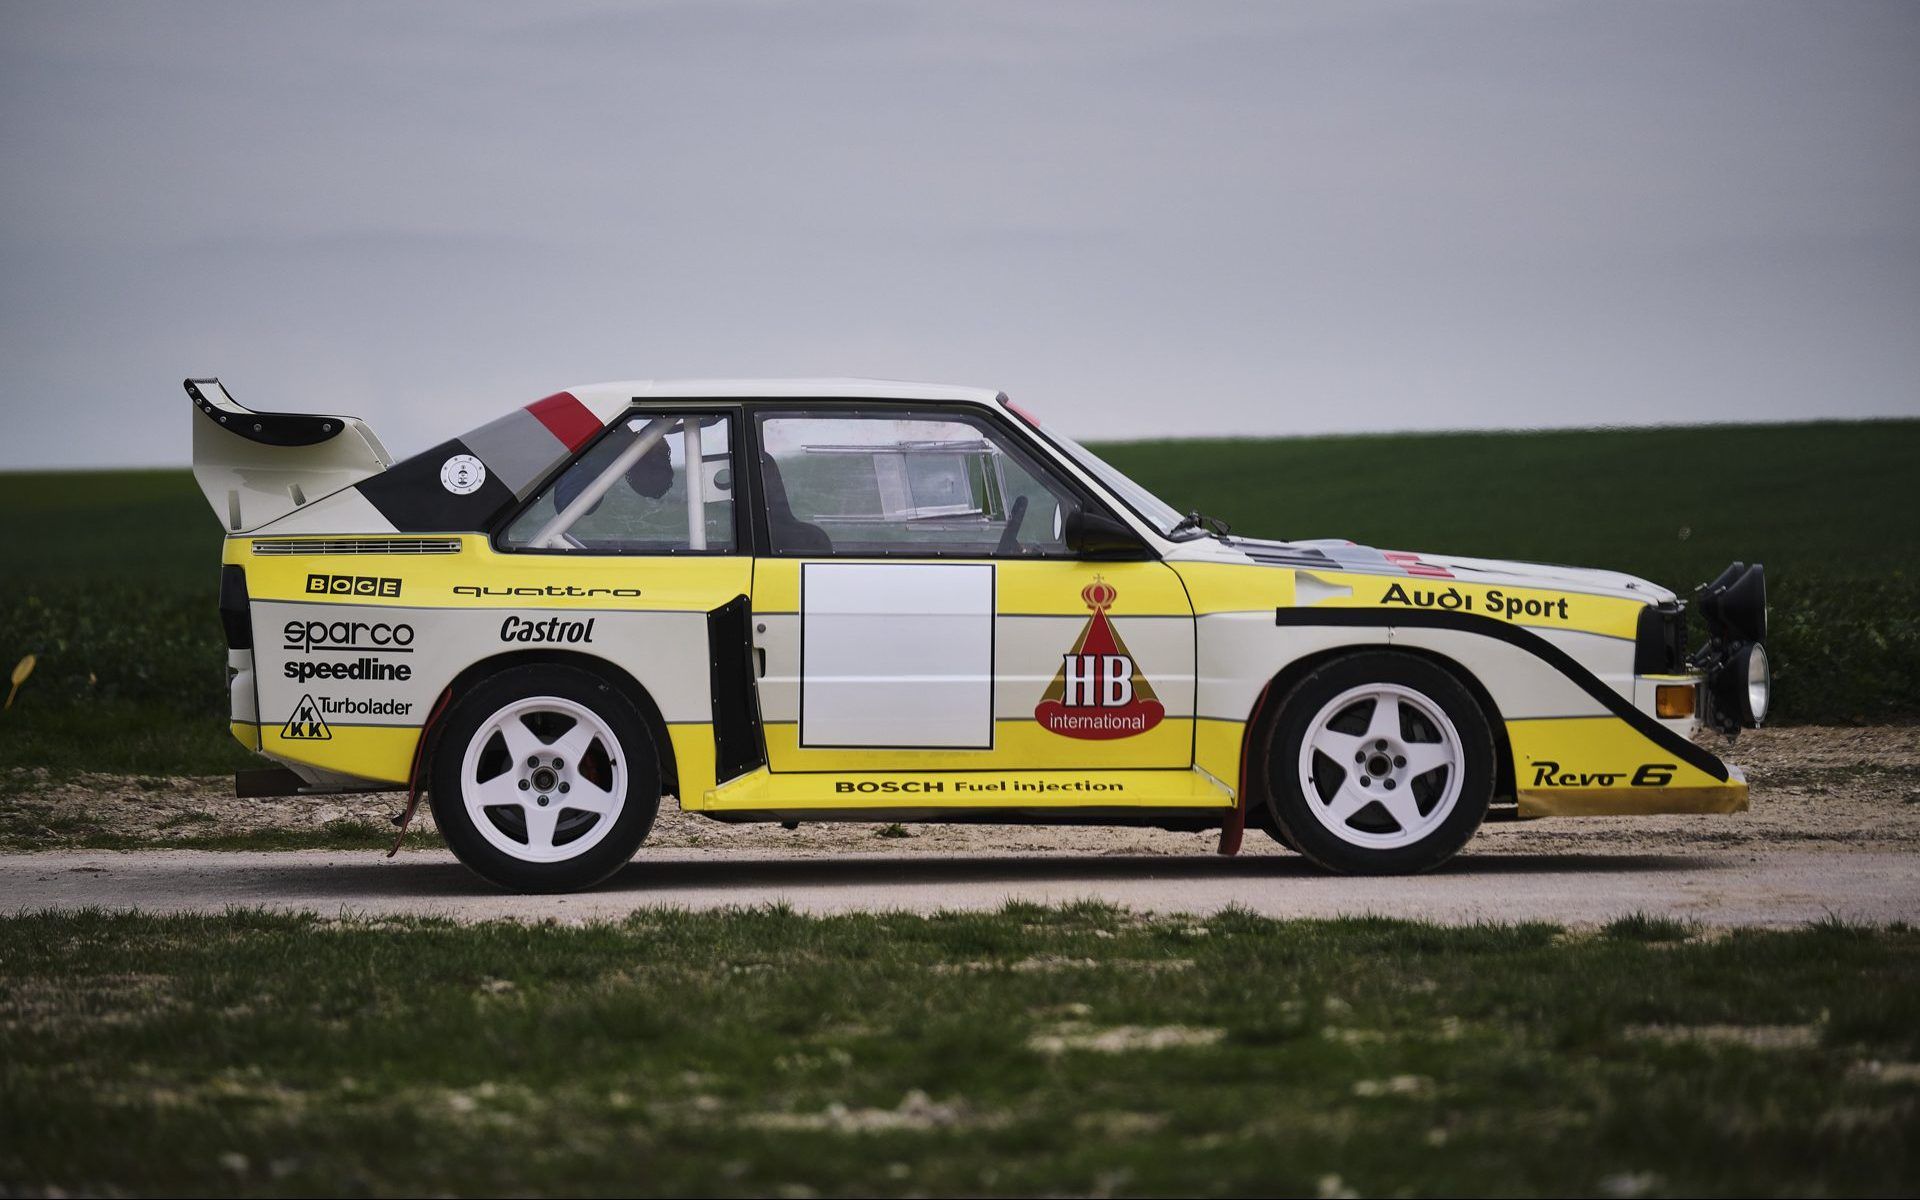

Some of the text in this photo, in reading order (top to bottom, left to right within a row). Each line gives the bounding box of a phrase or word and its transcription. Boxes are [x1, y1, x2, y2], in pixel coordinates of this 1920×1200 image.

[309, 576, 399, 596] BOGE
[453, 586, 641, 598] quattro
[1380, 583, 1568, 619] Audi Sport
[284, 621, 414, 653] sparco
[500, 616, 595, 643] Castrol
[284, 658, 411, 683] speedline
[1063, 653, 1133, 708] HB
[318, 697, 412, 715] Turbolader
[1050, 713, 1145, 729] international
[835, 780, 1124, 793] BOSCH Fuel injection
[1531, 761, 1677, 787] Revo 6
